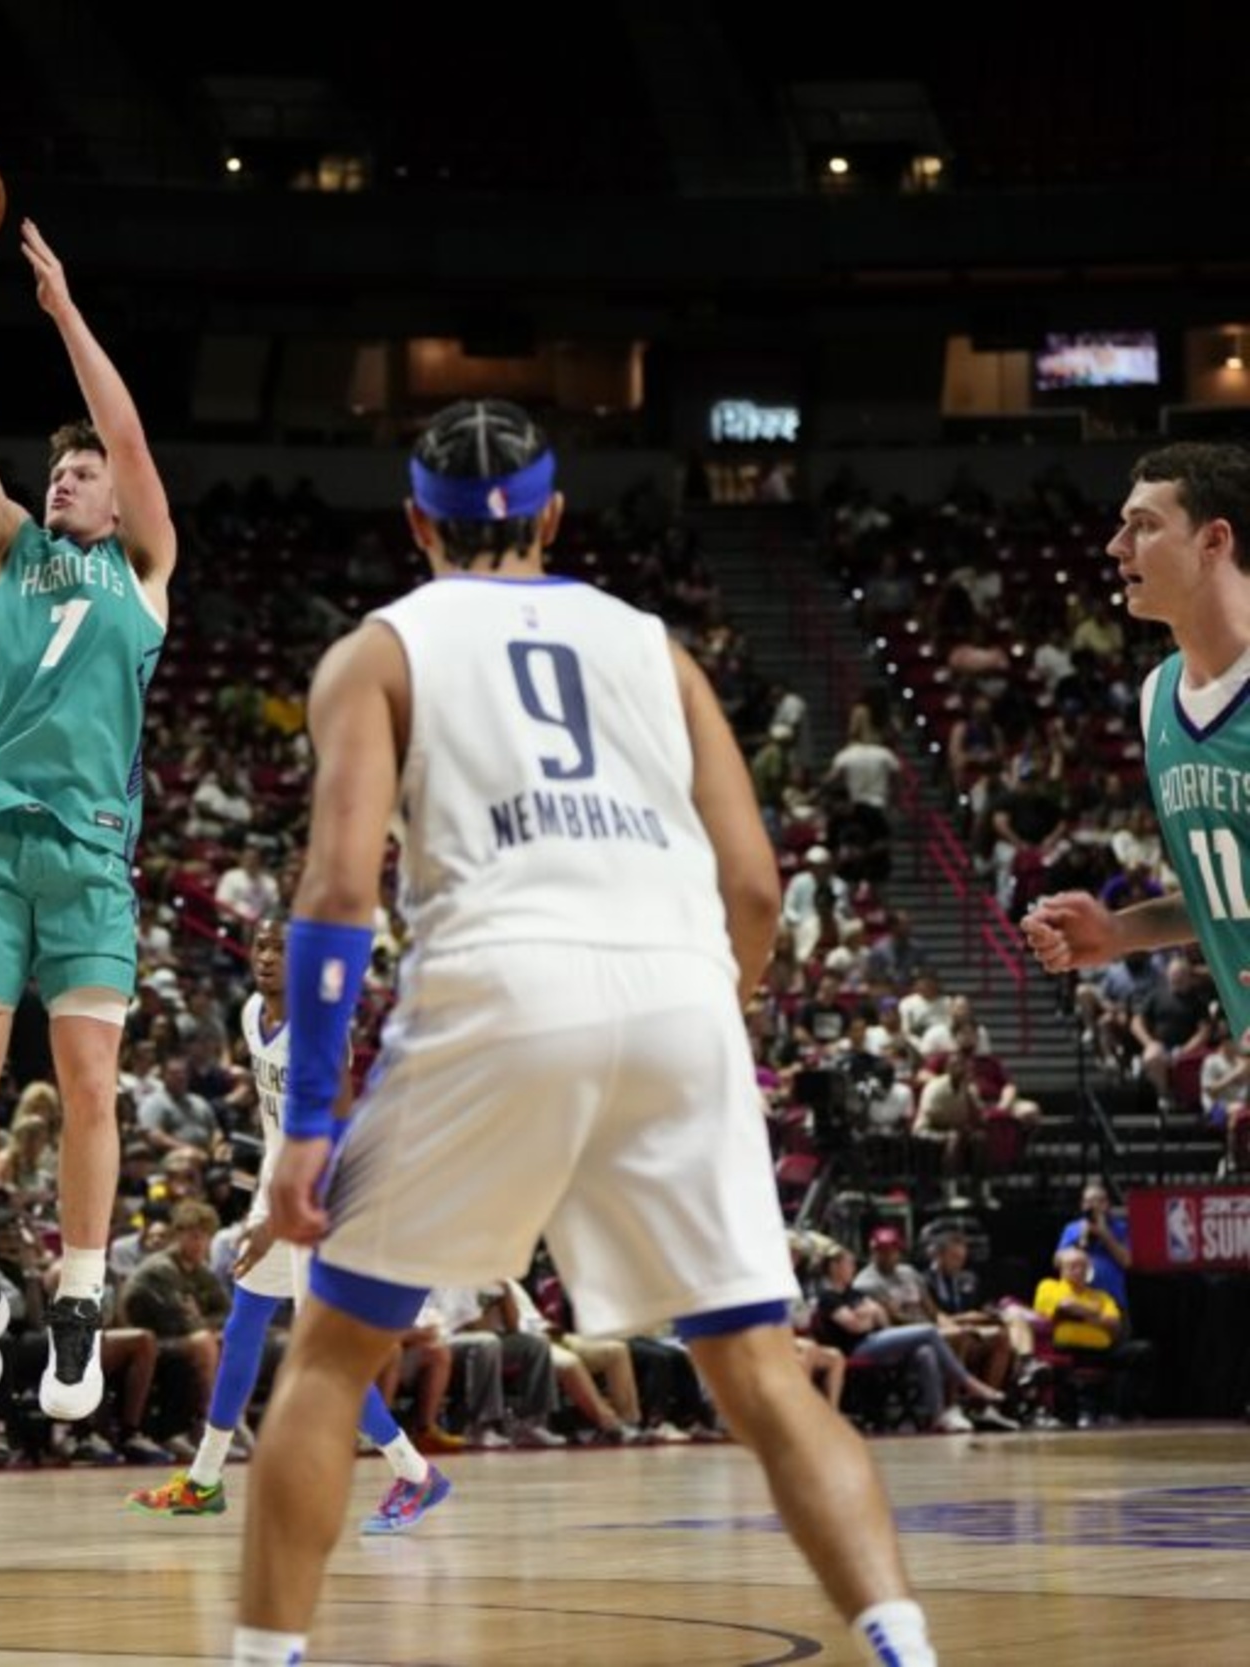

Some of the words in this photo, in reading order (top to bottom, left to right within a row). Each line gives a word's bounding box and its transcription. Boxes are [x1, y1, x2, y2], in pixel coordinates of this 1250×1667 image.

[21, 551, 125, 598] HORNETS
[507, 640, 595, 780] 9
[1188, 828, 1250, 920] 11
